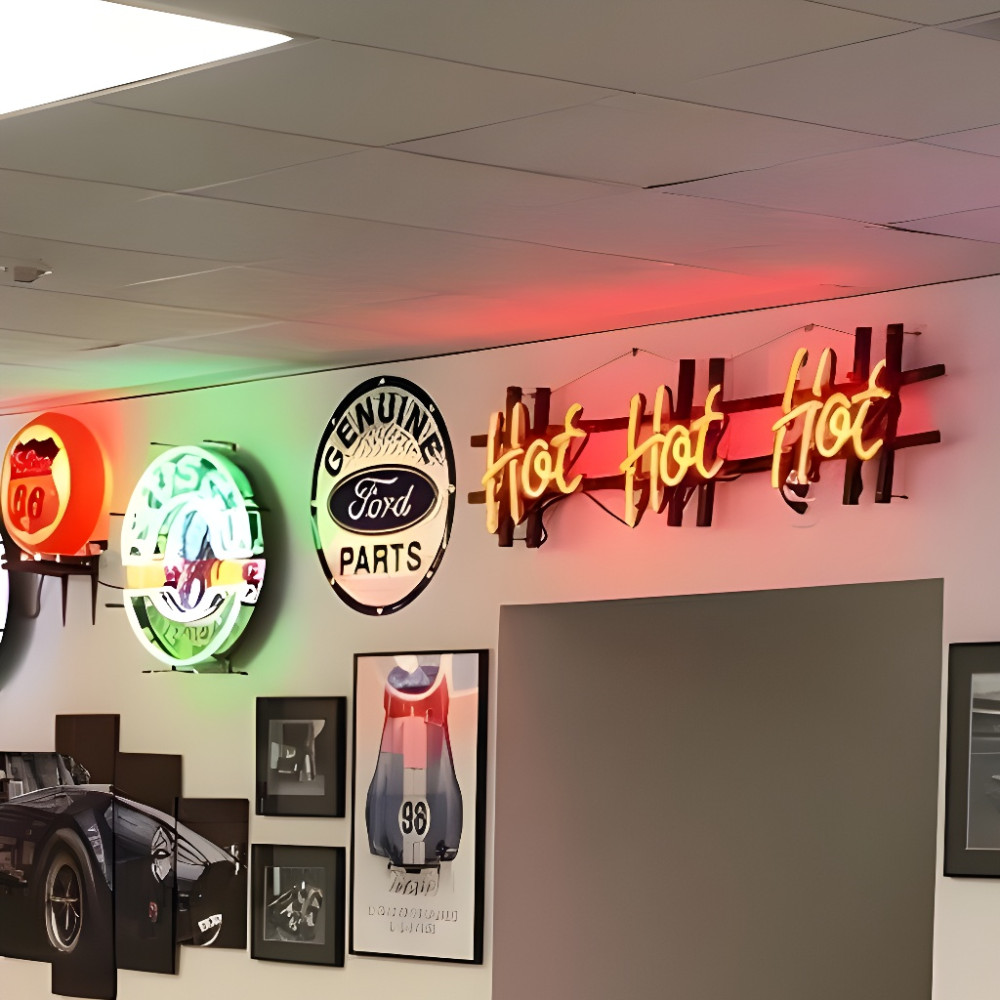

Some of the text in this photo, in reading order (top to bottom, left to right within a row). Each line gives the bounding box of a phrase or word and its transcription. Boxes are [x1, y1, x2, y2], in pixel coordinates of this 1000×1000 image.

[324, 392, 446, 478] GENUINE
[482, 347, 892, 535] Hot Hot Hot
[348, 476, 415, 521] Ford
[339, 541, 423, 576] PARTS
